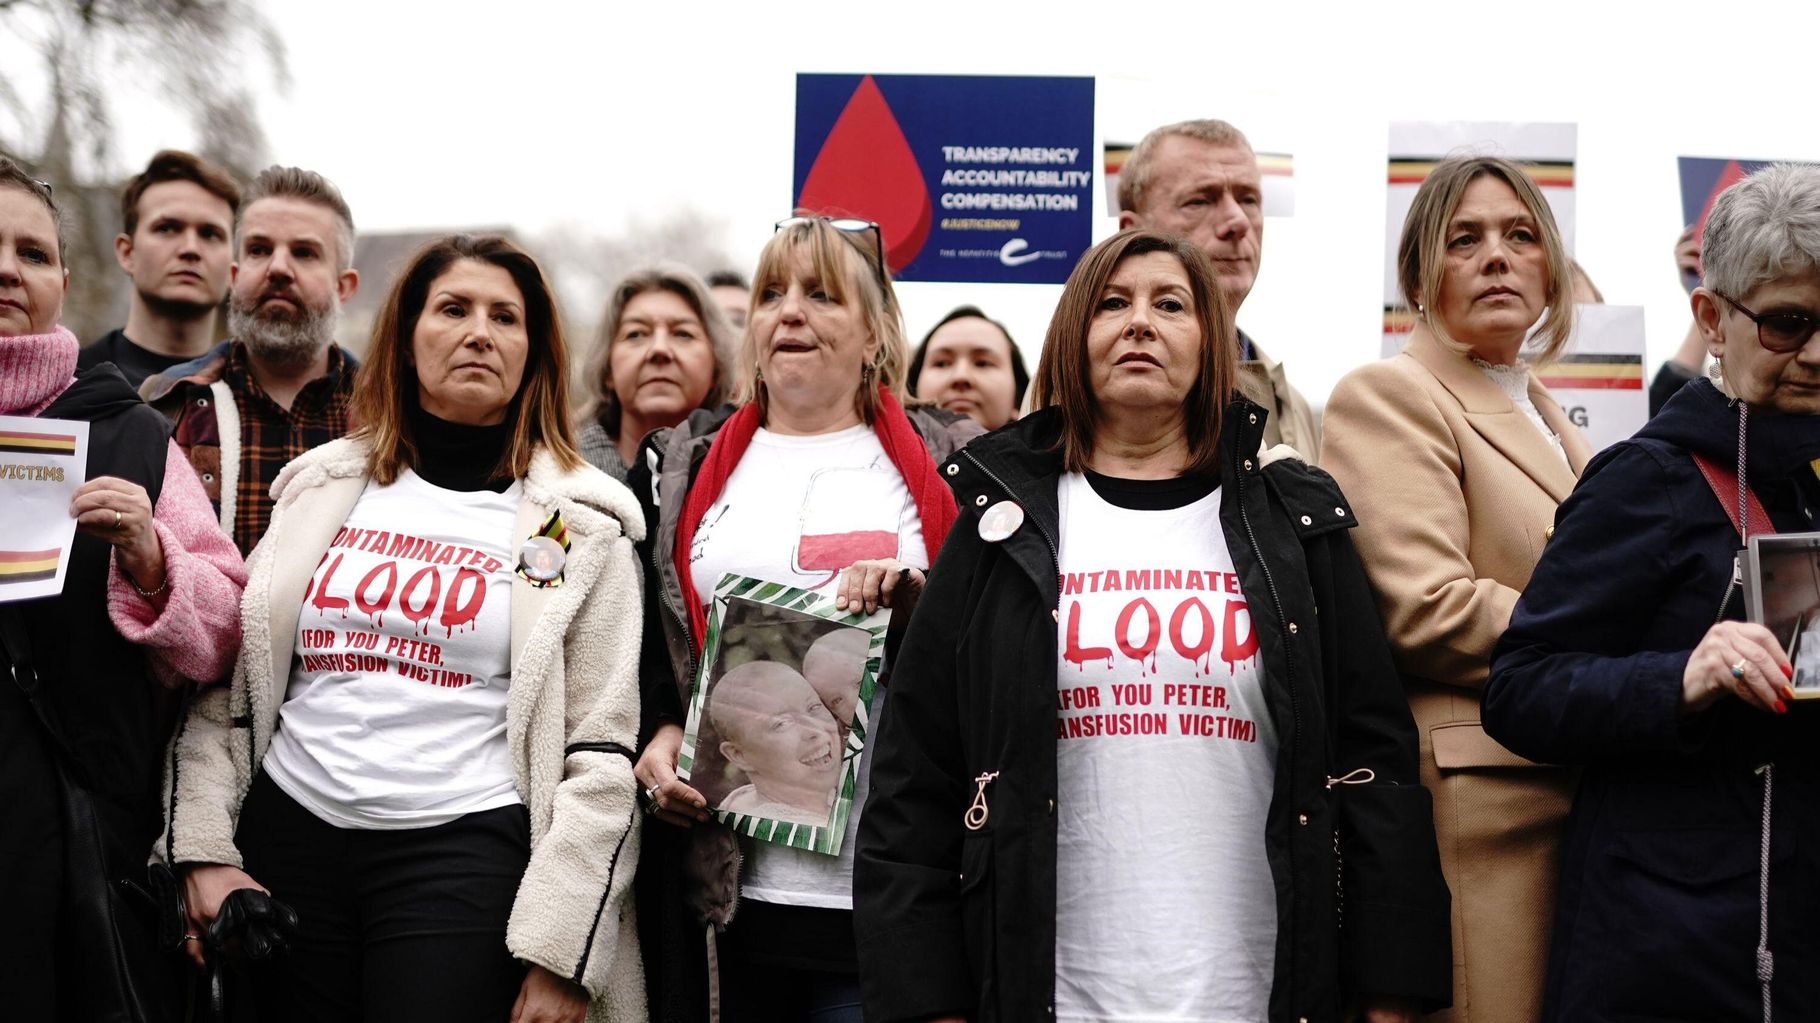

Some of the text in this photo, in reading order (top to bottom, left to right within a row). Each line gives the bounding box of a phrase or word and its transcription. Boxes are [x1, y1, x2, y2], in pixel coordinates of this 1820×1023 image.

[942, 146, 1078, 164] TRANSPARENCY
[941, 169, 1091, 187] ACCOUNTABILITY
[940, 192, 1078, 211] COMPENSATION
[0, 464, 65, 482] VICTIMS
[330, 527, 503, 573] ONTAMINATED
[1058, 569, 1244, 595] NTAMINATE
[304, 552, 487, 639] LOOD
[345, 631, 380, 650] YOU
[385, 636, 444, 667] PETER,
[1063, 596, 1260, 678] LOOD
[302, 653, 388, 674] ANSFUSION
[1111, 684, 1151, 706] YOU
[1163, 684, 1230, 711] PETER,
[1056, 713, 1257, 743] ANSFUSION VICTIM)
